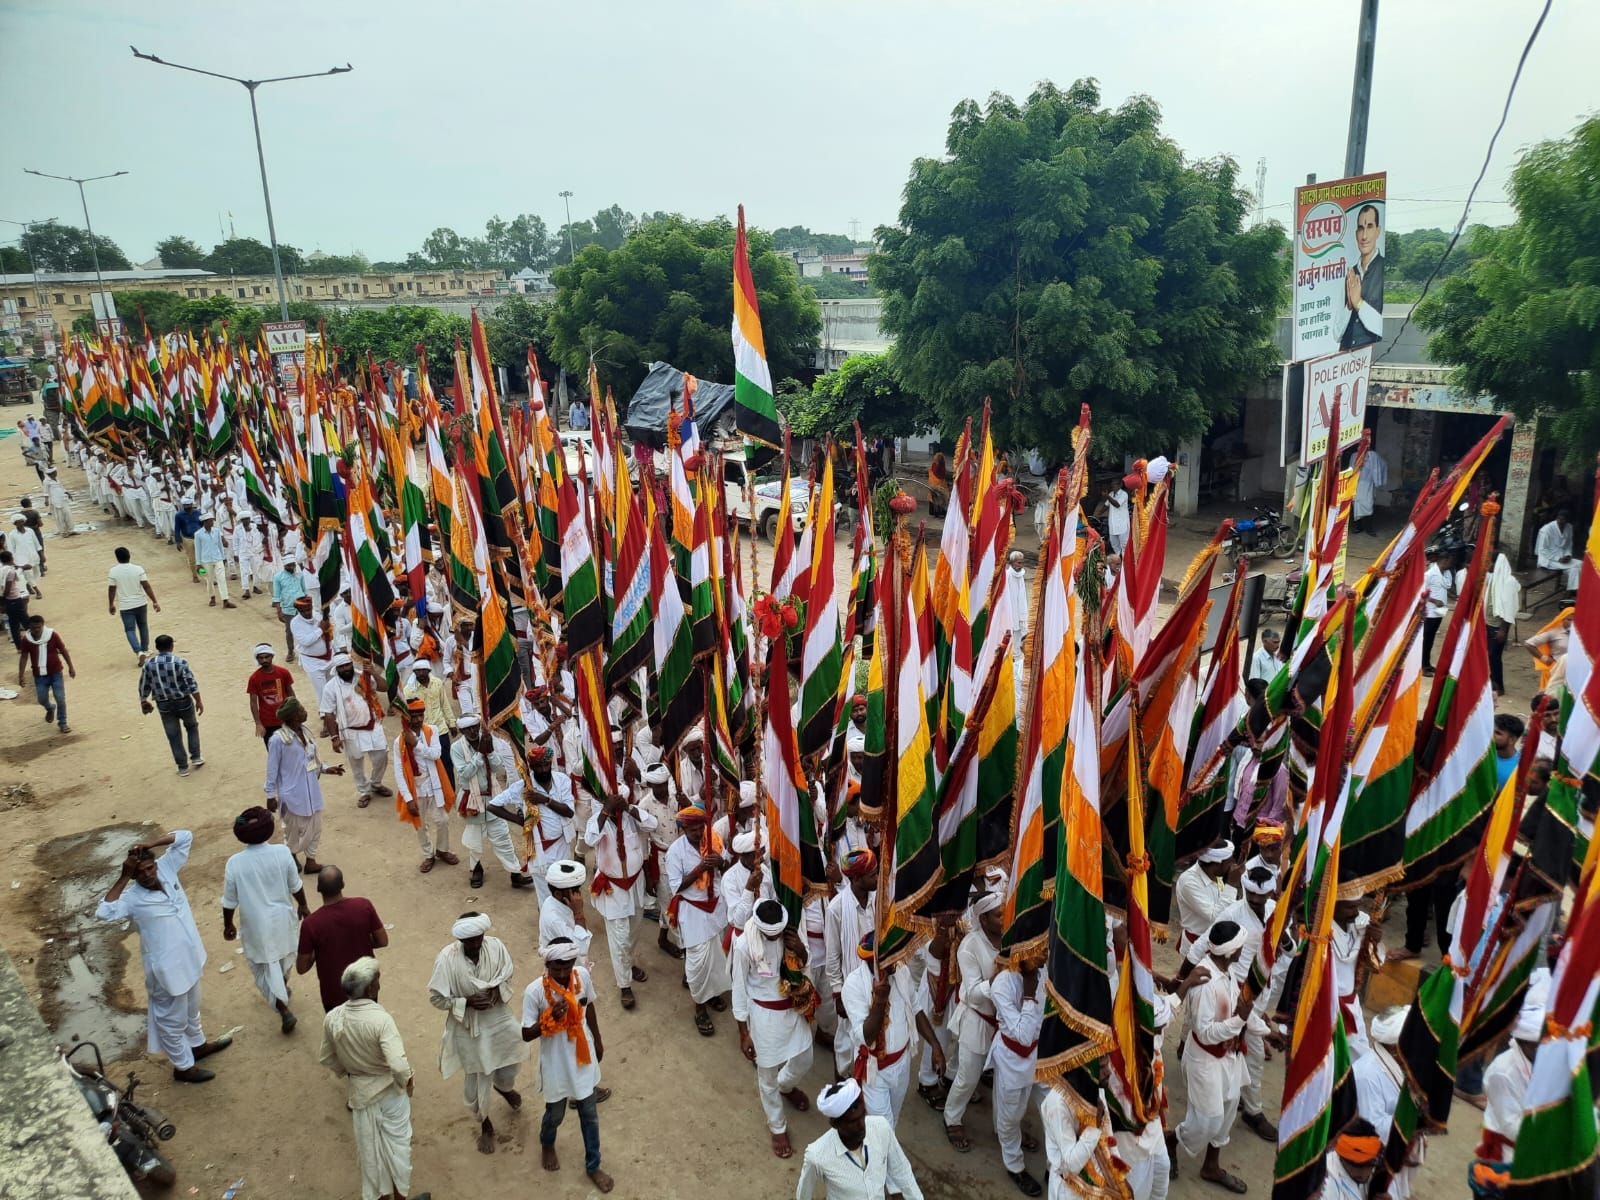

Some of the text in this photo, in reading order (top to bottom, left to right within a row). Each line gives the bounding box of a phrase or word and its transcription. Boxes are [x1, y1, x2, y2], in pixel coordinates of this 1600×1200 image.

[1305, 209, 1343, 240] सरपंच
[1298, 262, 1321, 290] अर्जुन
[1300, 296, 1331, 312] आप सभी
[1298, 311, 1332, 327] का हार्दिक
[1301, 325, 1329, 341] स्वागत है
[1314, 355, 1369, 386] POLE KIOSK
